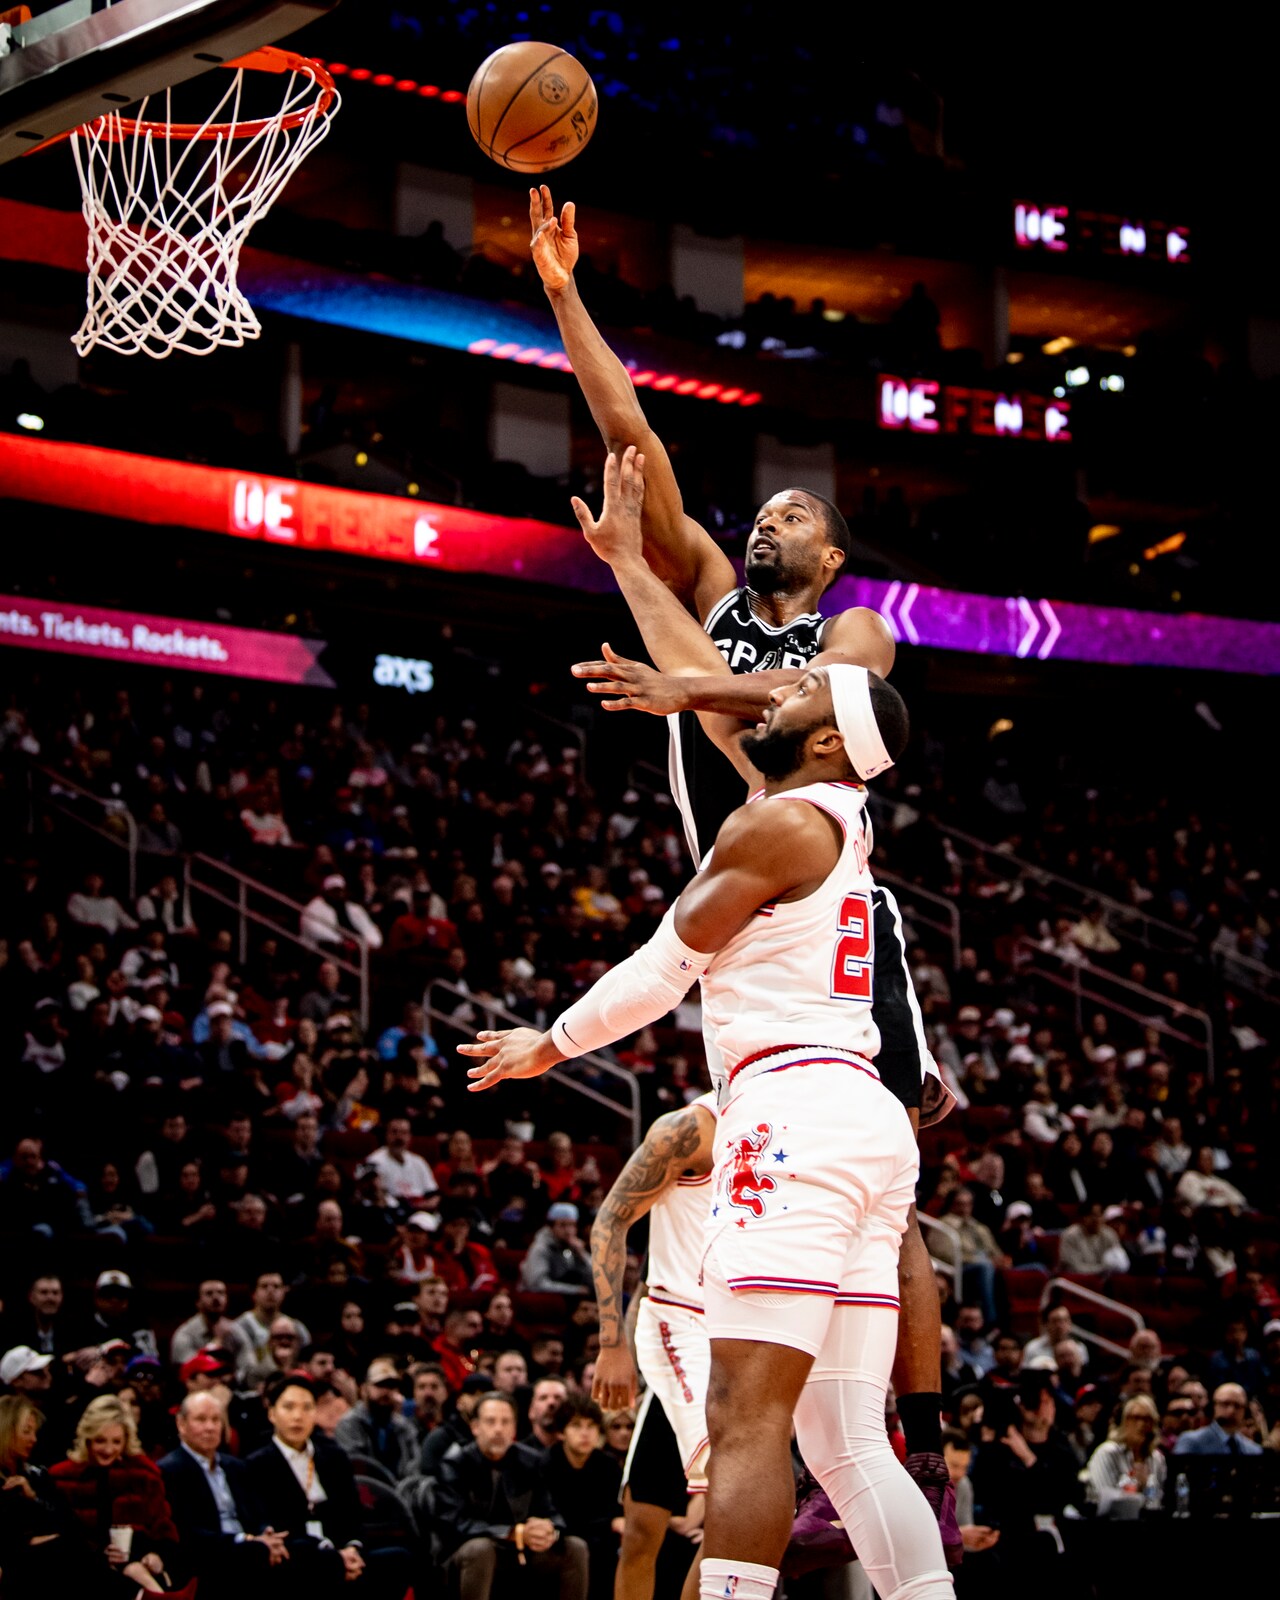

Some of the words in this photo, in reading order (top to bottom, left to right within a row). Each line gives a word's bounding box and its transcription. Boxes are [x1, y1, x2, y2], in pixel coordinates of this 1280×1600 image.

[878, 375, 1072, 441] DEFENSE
[41, 611, 130, 649] Tickets.
[132, 624, 229, 662] Rockets.
[373, 653, 434, 695] axs
